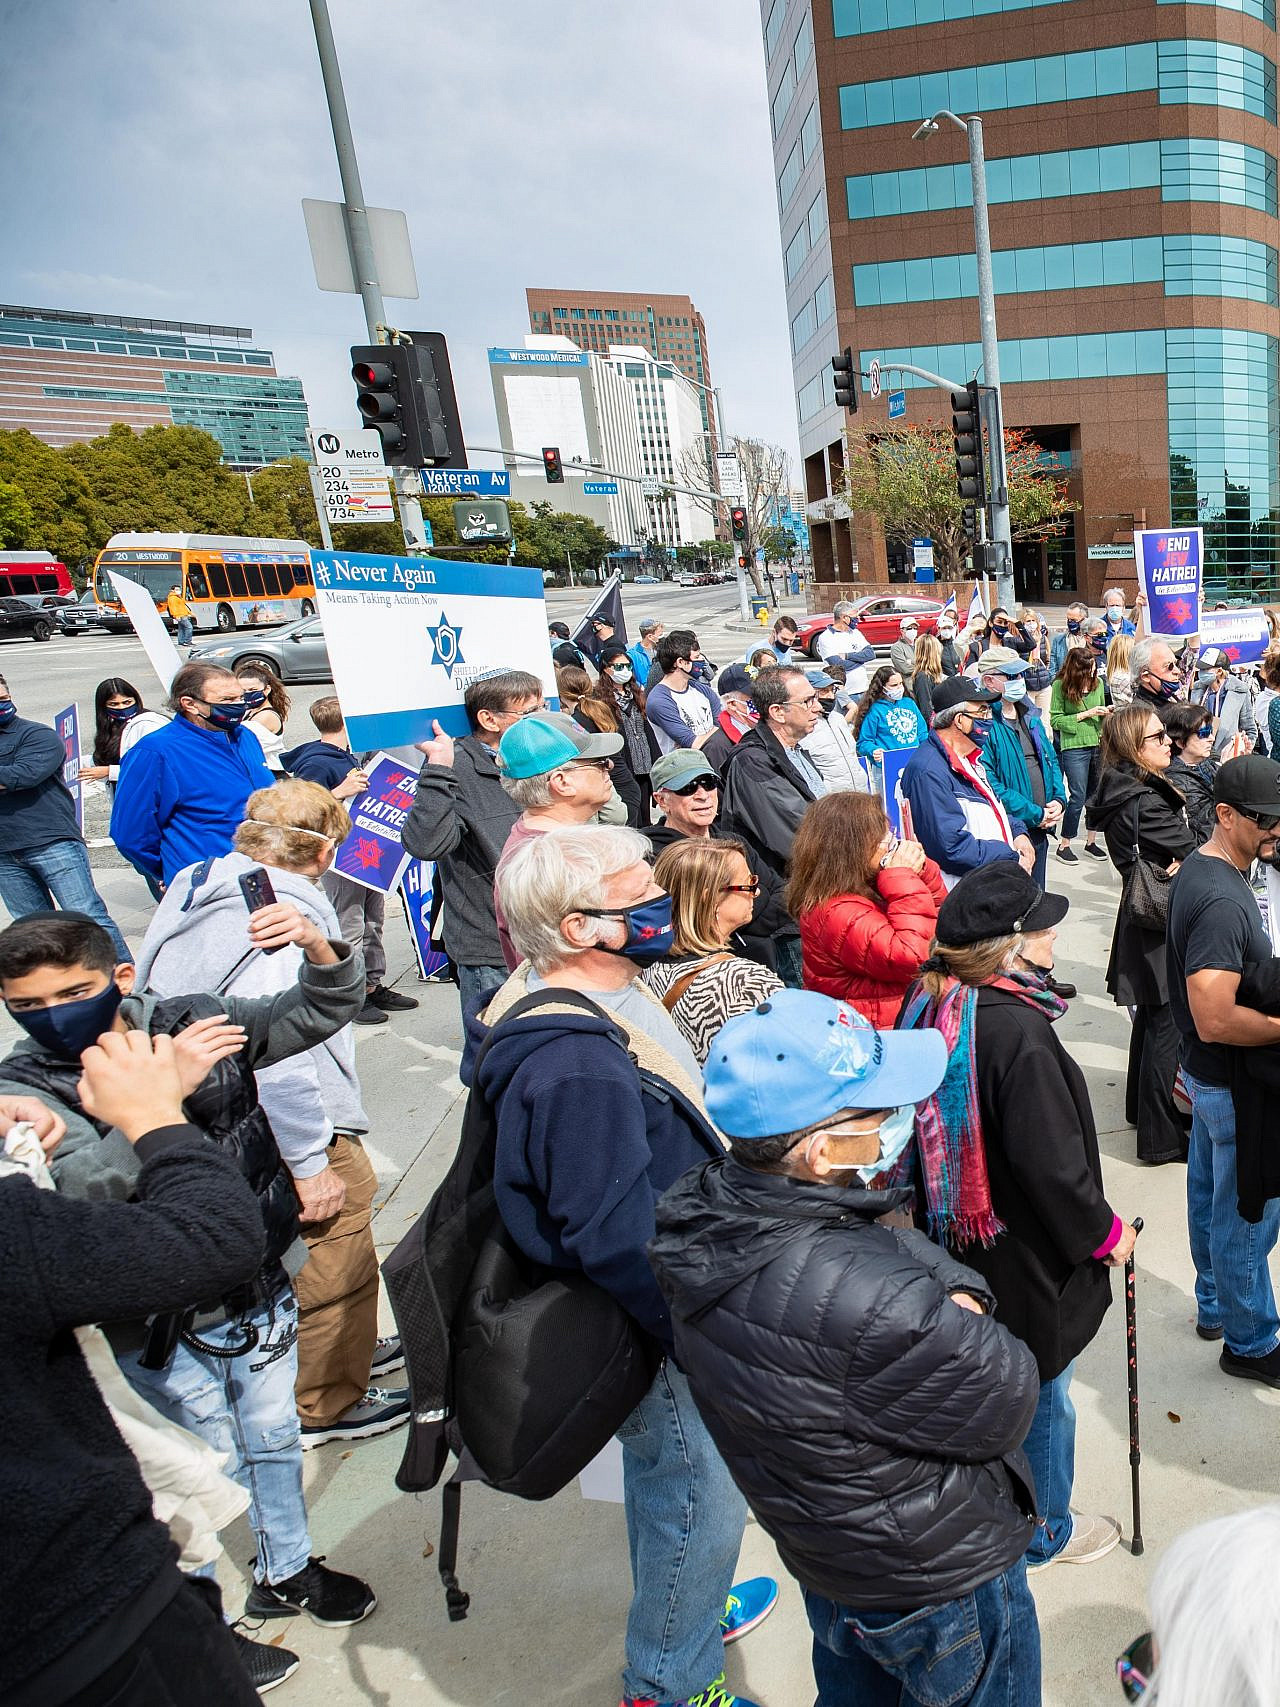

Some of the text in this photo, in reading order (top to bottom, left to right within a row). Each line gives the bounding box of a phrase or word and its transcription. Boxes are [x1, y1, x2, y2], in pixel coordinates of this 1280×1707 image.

[509, 351, 551, 361] WESTWOOD
[551, 353, 581, 363] MEDICAL
[346, 450, 379, 459] Metro
[322, 467, 341, 478] 20
[425, 471, 506, 486] Veteran Av
[325, 481, 349, 492] 234
[428, 484, 450, 493] 1200
[330, 508, 355, 518] 734
[1156, 536, 1190, 553] #END
[115, 552, 169, 560] 20 WESTWOOD
[1162, 552, 1189, 567] JEW
[335, 560, 387, 582] Never
[392, 563, 437, 591] Again
[1152, 565, 1197, 582] HATRED
[325, 592, 438, 608] Means Taking Action Now
[385, 771, 419, 796] #EN
[359, 796, 408, 828] HATRE
